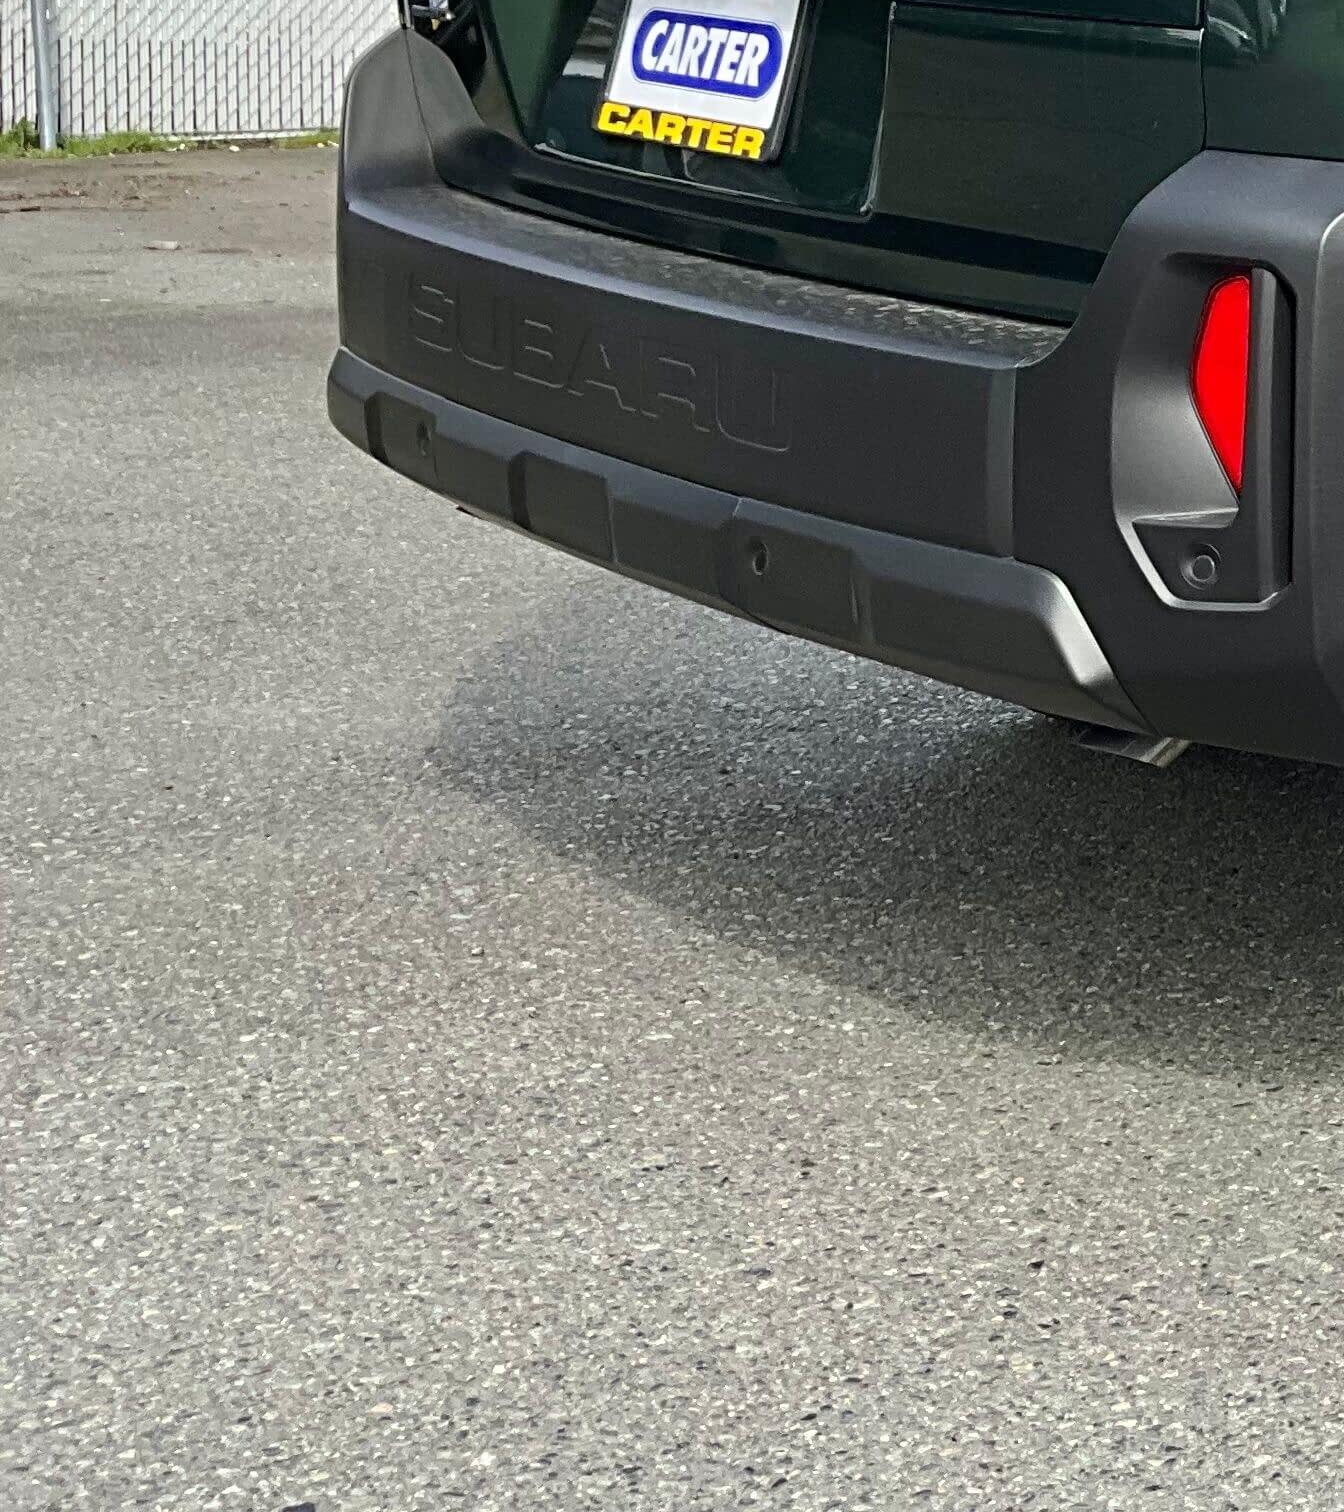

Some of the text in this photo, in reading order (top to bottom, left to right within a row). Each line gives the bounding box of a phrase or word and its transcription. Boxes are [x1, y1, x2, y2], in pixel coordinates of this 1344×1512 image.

[641, 18, 770, 88] CARTER
[597, 101, 766, 160] CARTER
[408, 278, 793, 453] SUBARU
